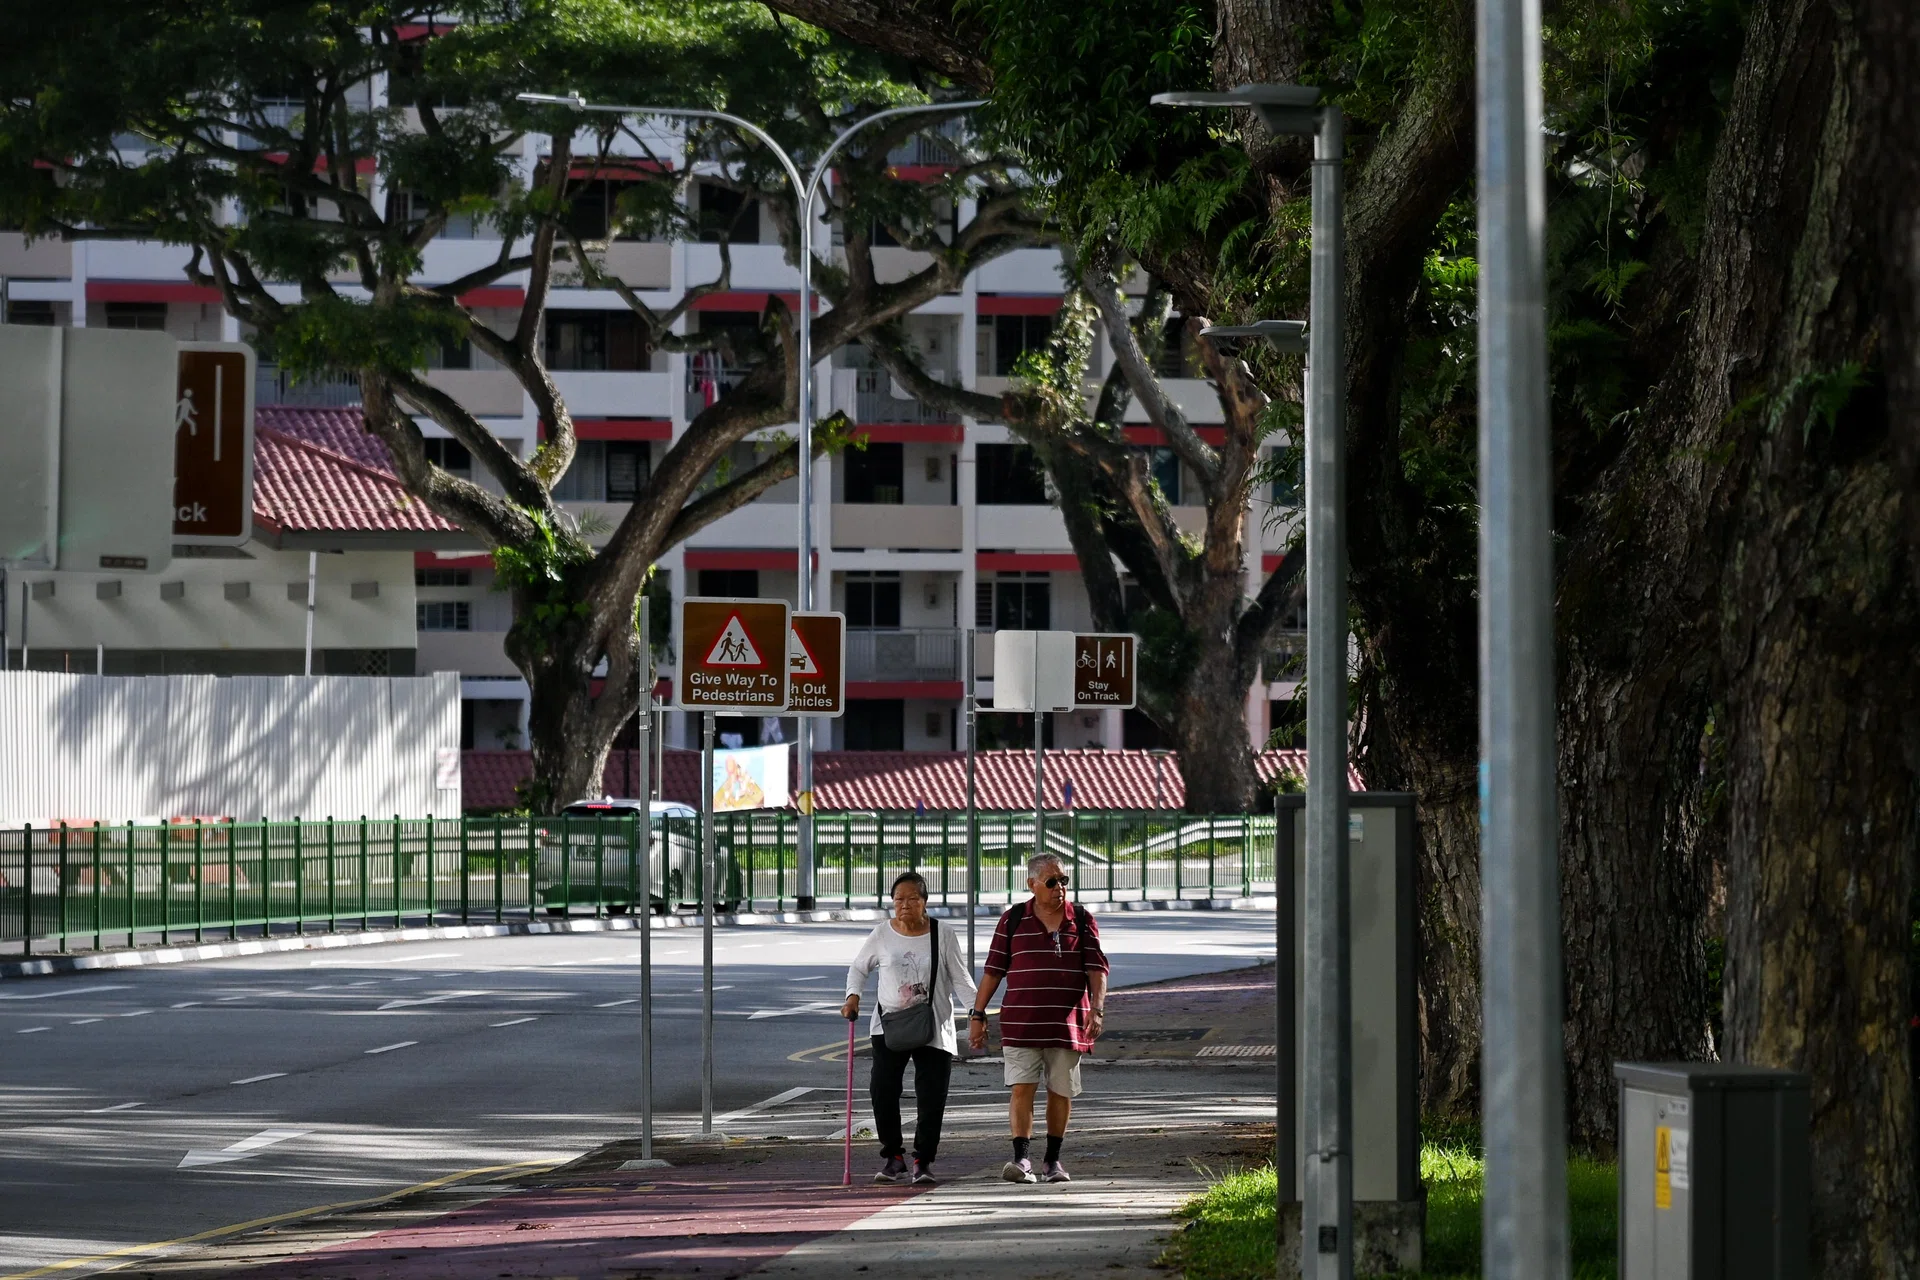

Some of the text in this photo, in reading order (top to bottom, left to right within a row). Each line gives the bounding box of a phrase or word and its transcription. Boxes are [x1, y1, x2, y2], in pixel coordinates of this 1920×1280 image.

[175, 502, 208, 522] ck
[690, 673, 778, 688] Give Way To
[1088, 681, 1109, 691] Stay
[803, 683, 827, 694] Out
[692, 689, 775, 702] Pedestrians
[1077, 691, 1120, 700] On Track
[789, 696, 833, 707] ehicles
